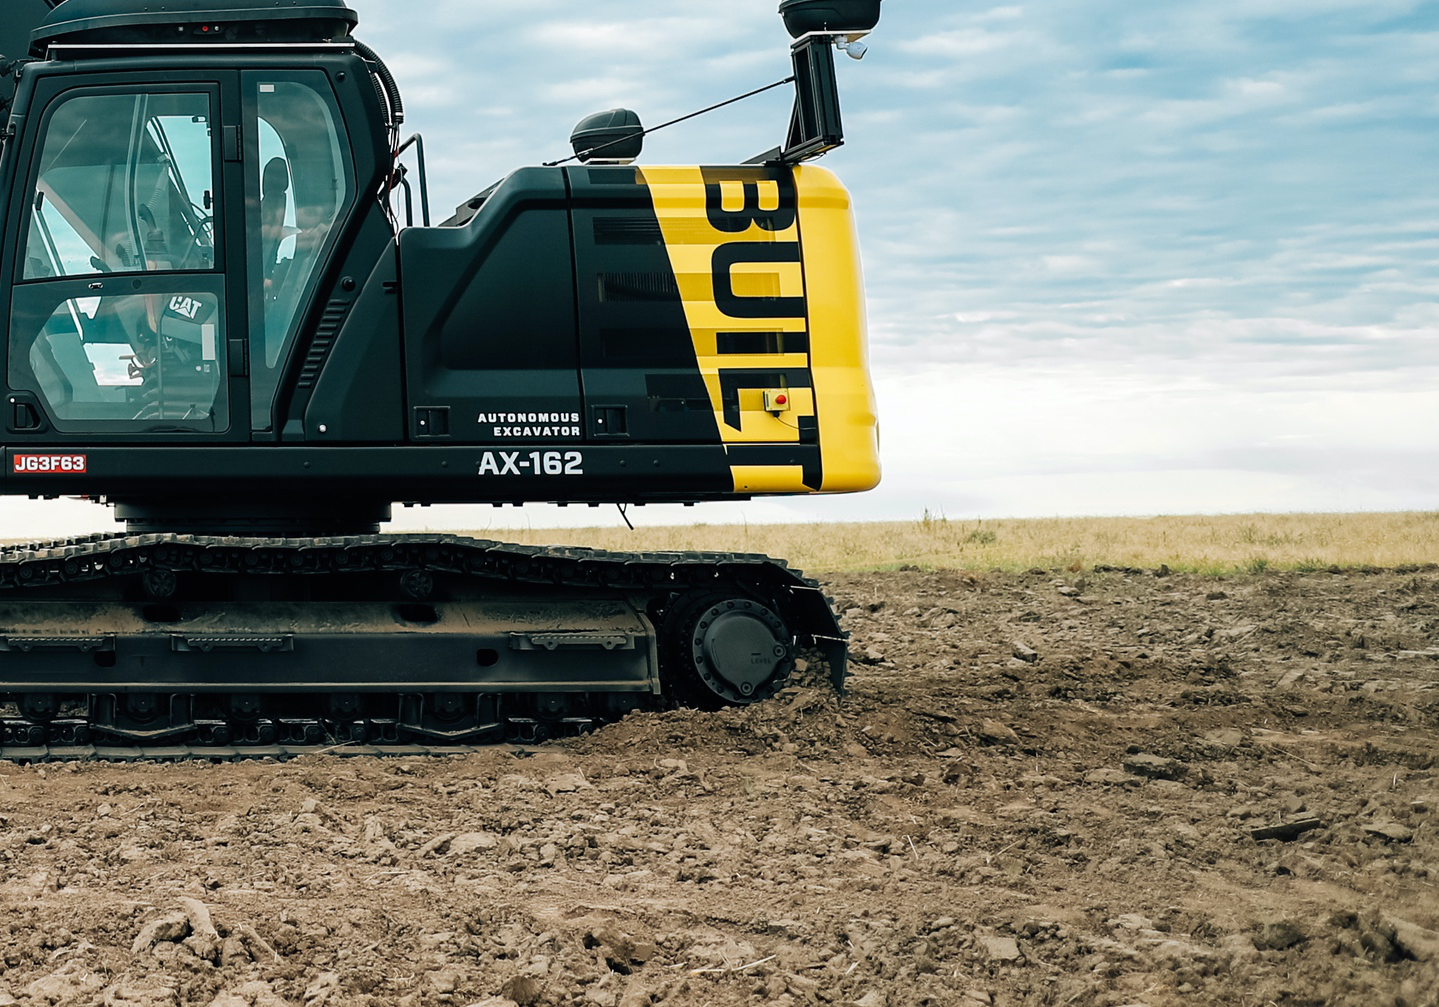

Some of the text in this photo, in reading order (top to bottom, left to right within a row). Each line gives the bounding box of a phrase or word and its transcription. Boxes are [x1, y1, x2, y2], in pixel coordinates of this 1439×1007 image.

[169, 296, 202, 319] CAT
[699, 166, 822, 491] BUILT
[478, 413, 579, 422] AUTONOMOUS
[494, 427, 580, 436] EXCAVATOR
[15, 456, 84, 470] JG3F63
[478, 452, 583, 475] AX-162
